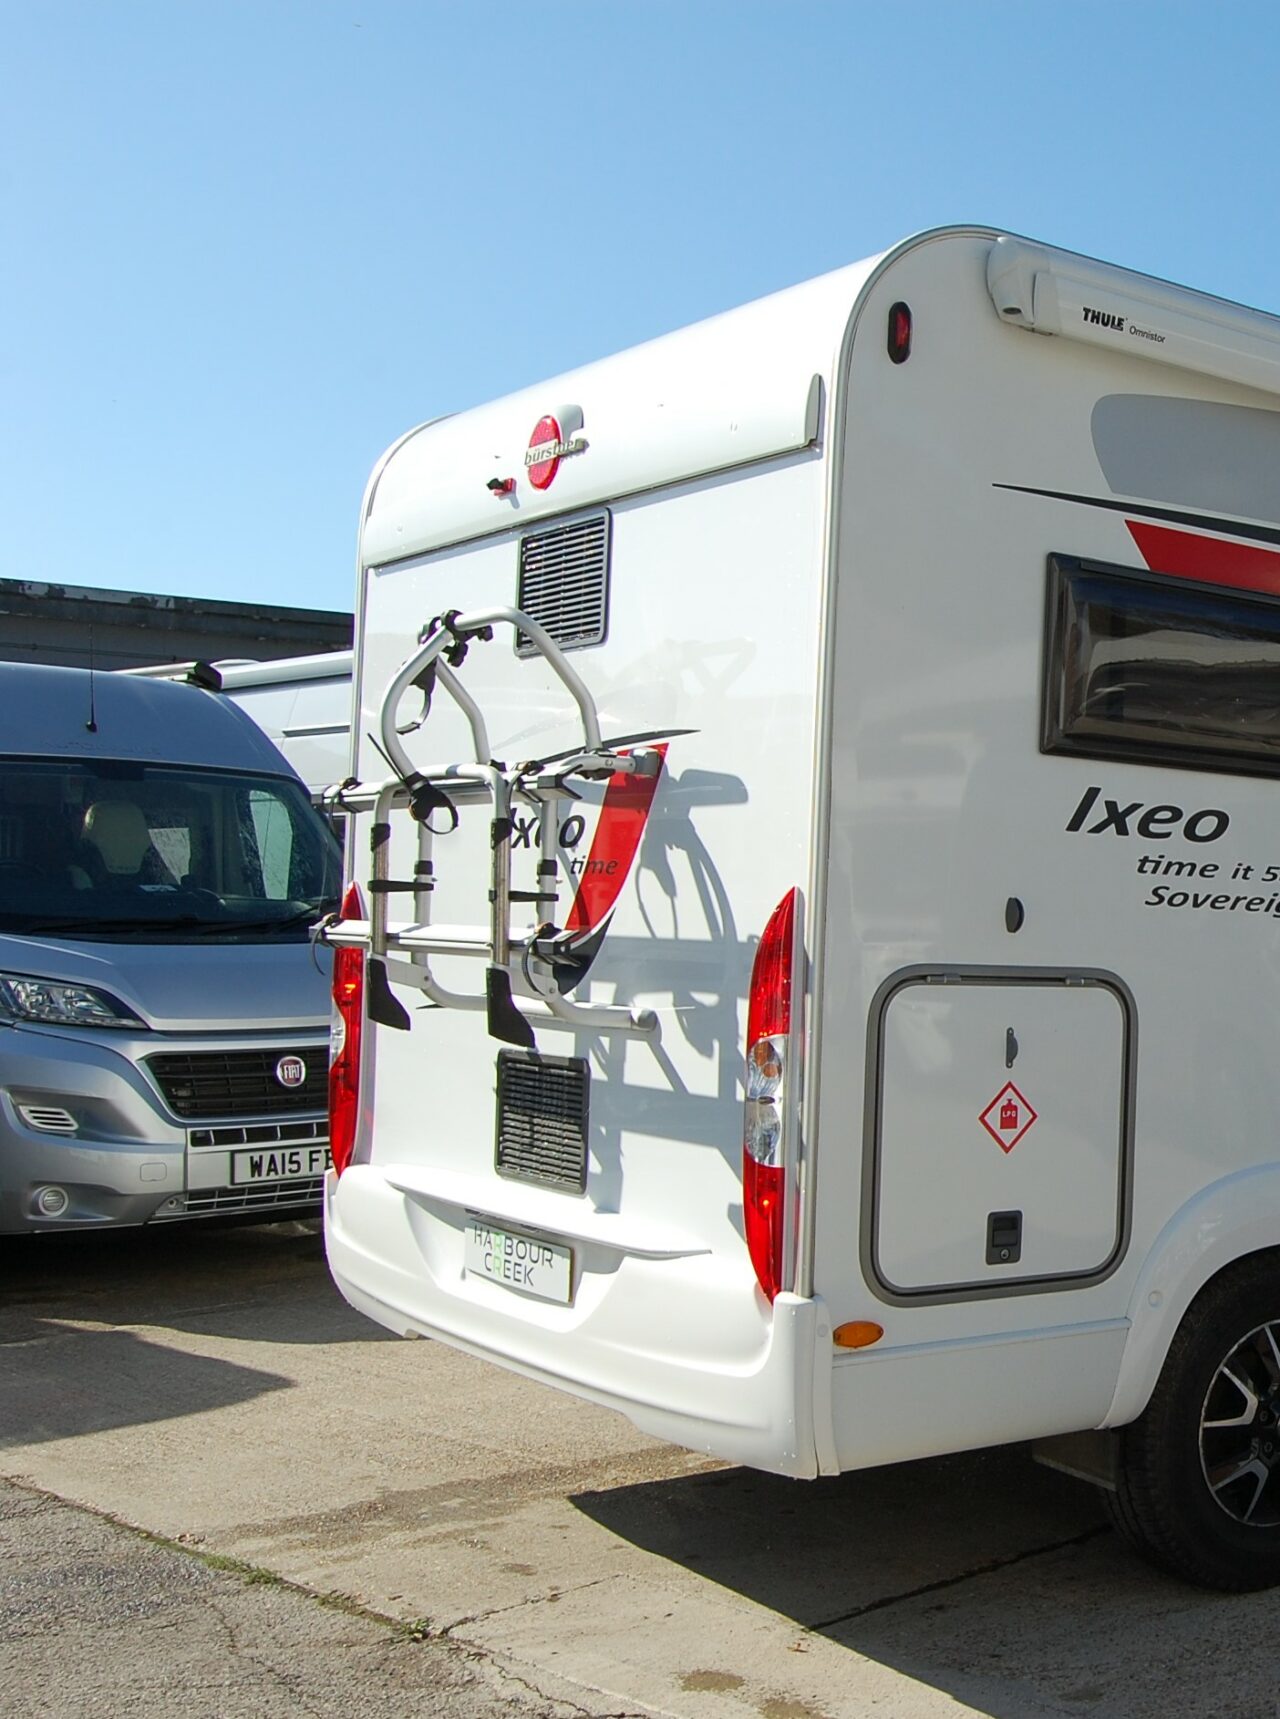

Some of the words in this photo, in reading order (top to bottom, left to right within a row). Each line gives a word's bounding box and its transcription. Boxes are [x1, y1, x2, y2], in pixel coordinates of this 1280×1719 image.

[1082, 306, 1125, 332] THULE
[1129, 325, 1166, 343] Omnistor
[1065, 786, 1231, 843] Ixeo
[570, 855, 619, 875] time
[1136, 854, 1220, 878] time
[1231, 863, 1255, 880] it
[284, 1064, 300, 1080] FIAT
[1002, 1110, 1017, 1118] LPG
[249, 1151, 302, 1178] WA15
[474, 1224, 554, 1269] HARBOUR
[484, 1252, 535, 1287] CREEK
